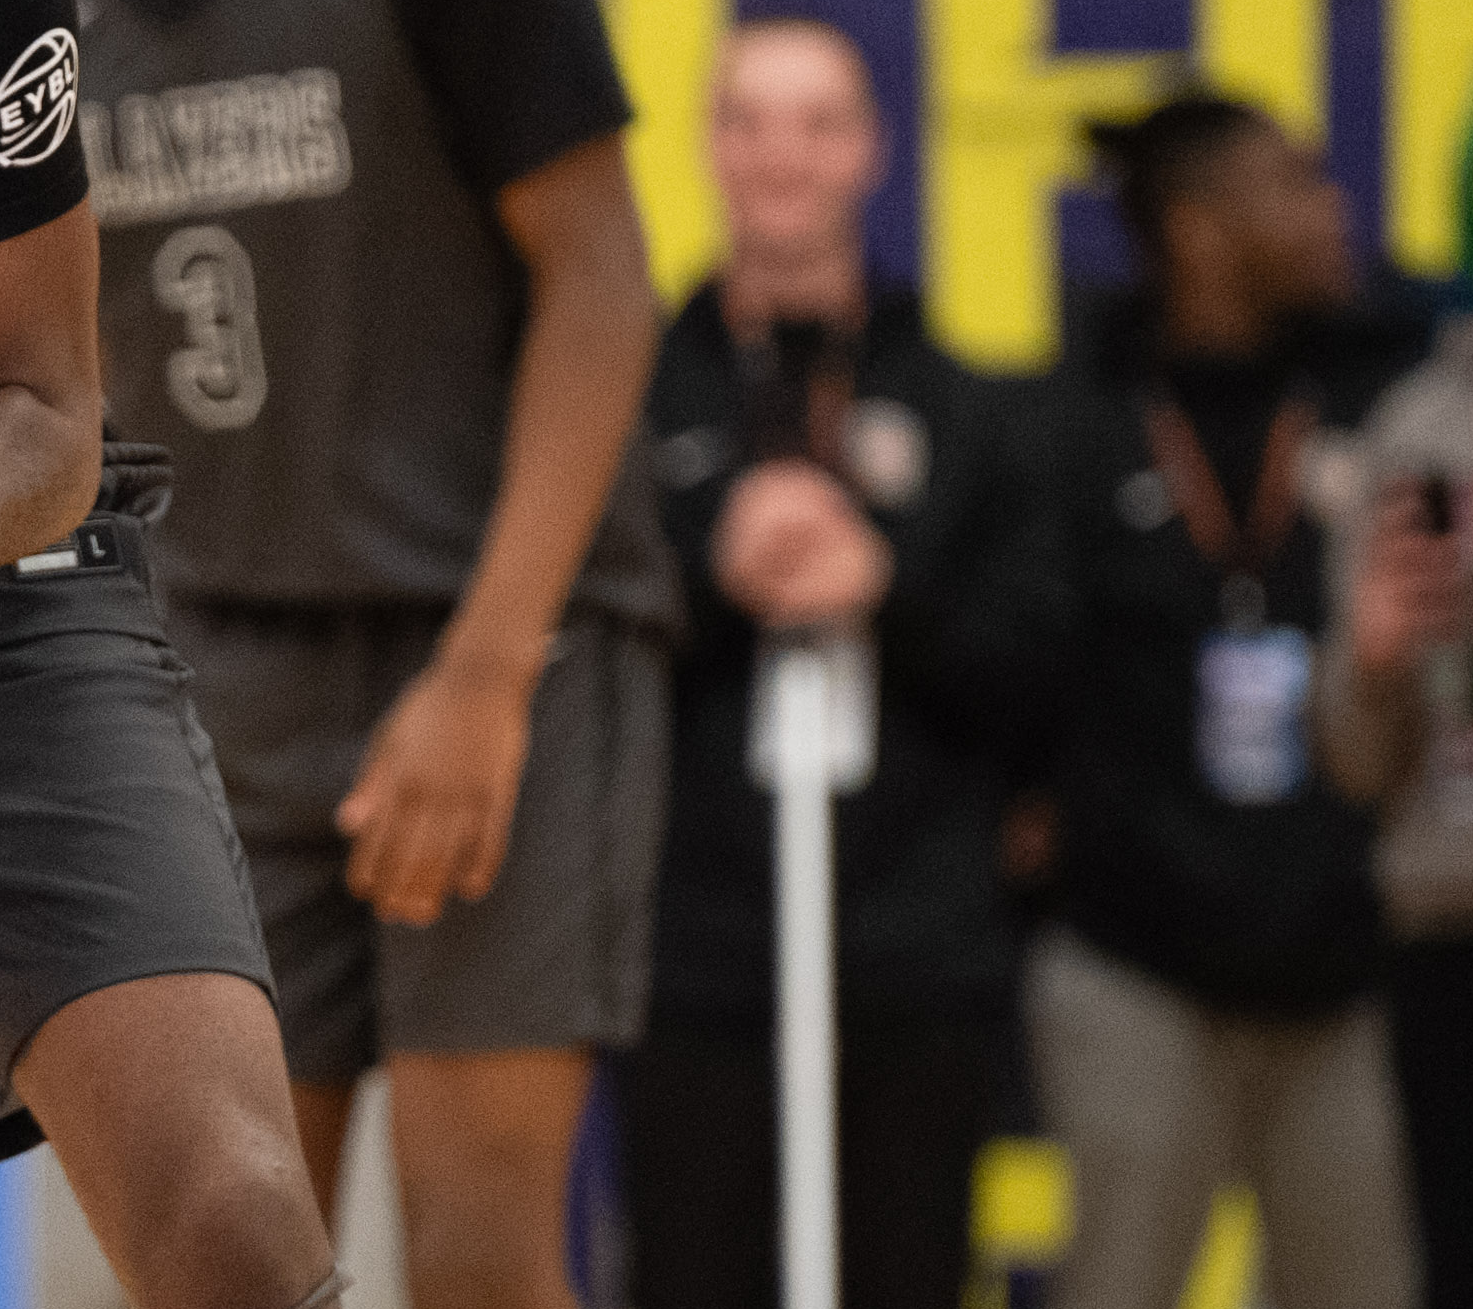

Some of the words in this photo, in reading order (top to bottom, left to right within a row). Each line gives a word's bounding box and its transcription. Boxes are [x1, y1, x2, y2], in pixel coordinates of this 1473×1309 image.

[0, 58, 74, 132] EYBL
[76, 66, 355, 229] LAZERS
[155, 224, 268, 432] 3
